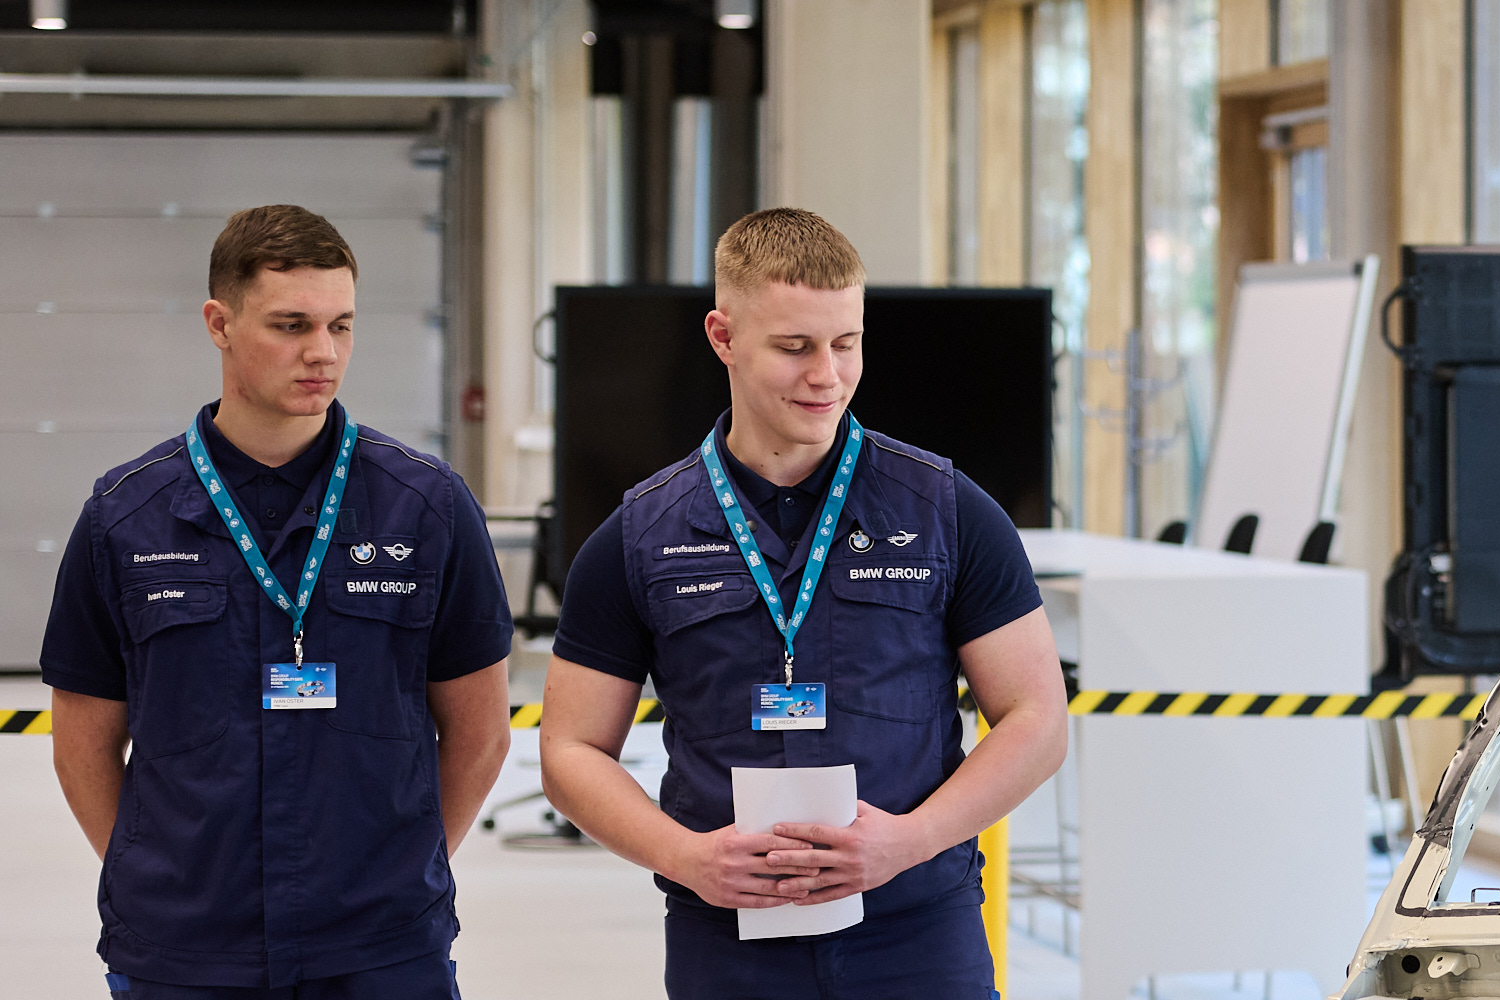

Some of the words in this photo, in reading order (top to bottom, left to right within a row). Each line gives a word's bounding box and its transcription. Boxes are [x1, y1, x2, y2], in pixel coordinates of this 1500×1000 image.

[663, 543, 730, 555] Berufsausbildung
[133, 553, 199, 563] Berufsausbildung
[849, 568, 883, 579] BMW
[885, 568, 931, 580] GROUP
[346, 581, 379, 593] BMW
[380, 581, 417, 594] GROUP
[676, 584, 698, 594] Louis
[698, 581, 724, 592] Rieger
[147, 592, 162, 601] Ivan
[163, 590, 185, 598] Oster
